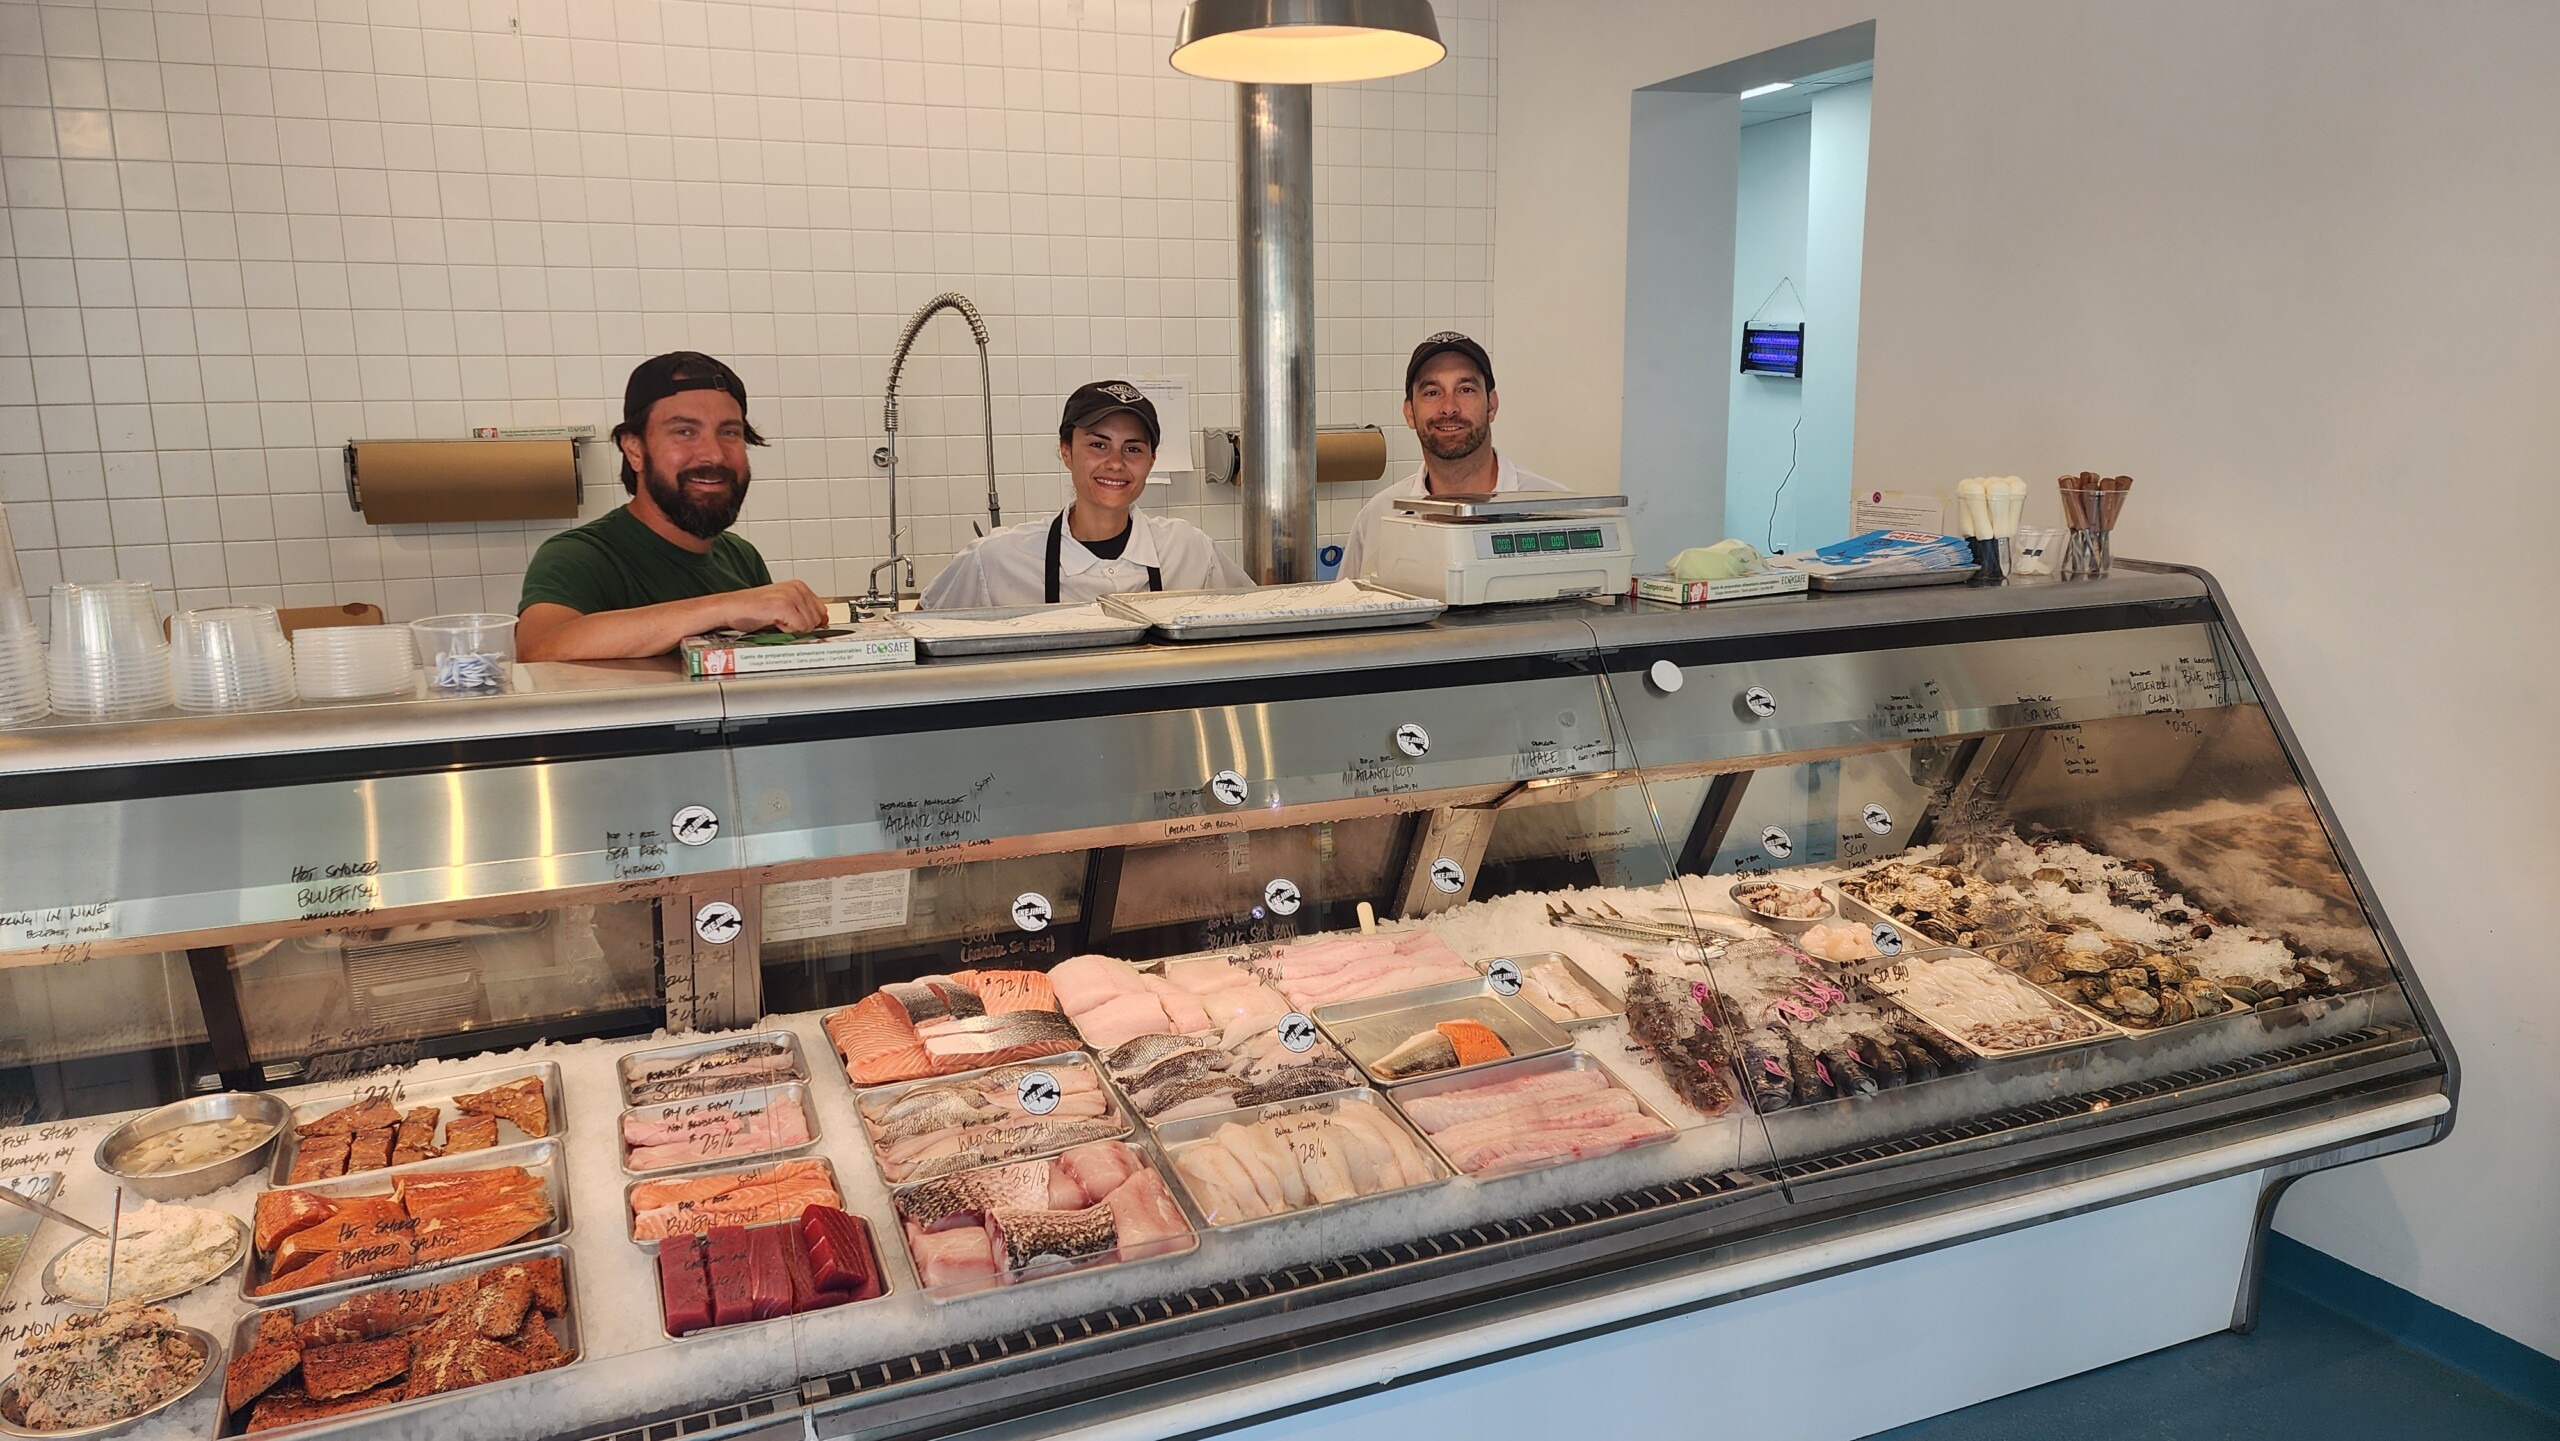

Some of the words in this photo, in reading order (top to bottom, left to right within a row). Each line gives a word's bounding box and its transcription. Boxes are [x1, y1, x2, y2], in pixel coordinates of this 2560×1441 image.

[1643, 582, 1674, 592] Compostable
[867, 642, 909, 654] ECOSAFE
[1529, 750, 1559, 768] HAKE
[885, 813, 934, 834] ATLANTIC
[937, 804, 982, 826] SALMON
[605, 846, 630, 863] SEA
[1844, 842, 1868, 858] SCUP
[291, 865, 318, 884] HOT
[1435, 871, 1460, 880] IKEJIME
[297, 882, 381, 908] BLUEFISH
[46, 908, 62, 923] IN
[70, 901, 110, 920] WINE
[1017, 906, 1047, 918] IKEJIME
[1492, 972, 1518, 982] IKEJIME
[652, 1078, 706, 1102] SALMON
[1026, 1081, 1053, 1106] IKEJIME
[39, 1125, 79, 1142] SALAD
[957, 1134, 984, 1153] WILD
[338, 1222, 367, 1243] HOT
[666, 1214, 720, 1239] BLUEFIN
[725, 1207, 760, 1227] TUNA
[340, 1242, 402, 1271] PEPPERED
[407, 1226, 462, 1256] SALMON
[0, 1313, 58, 1345] ALMON
